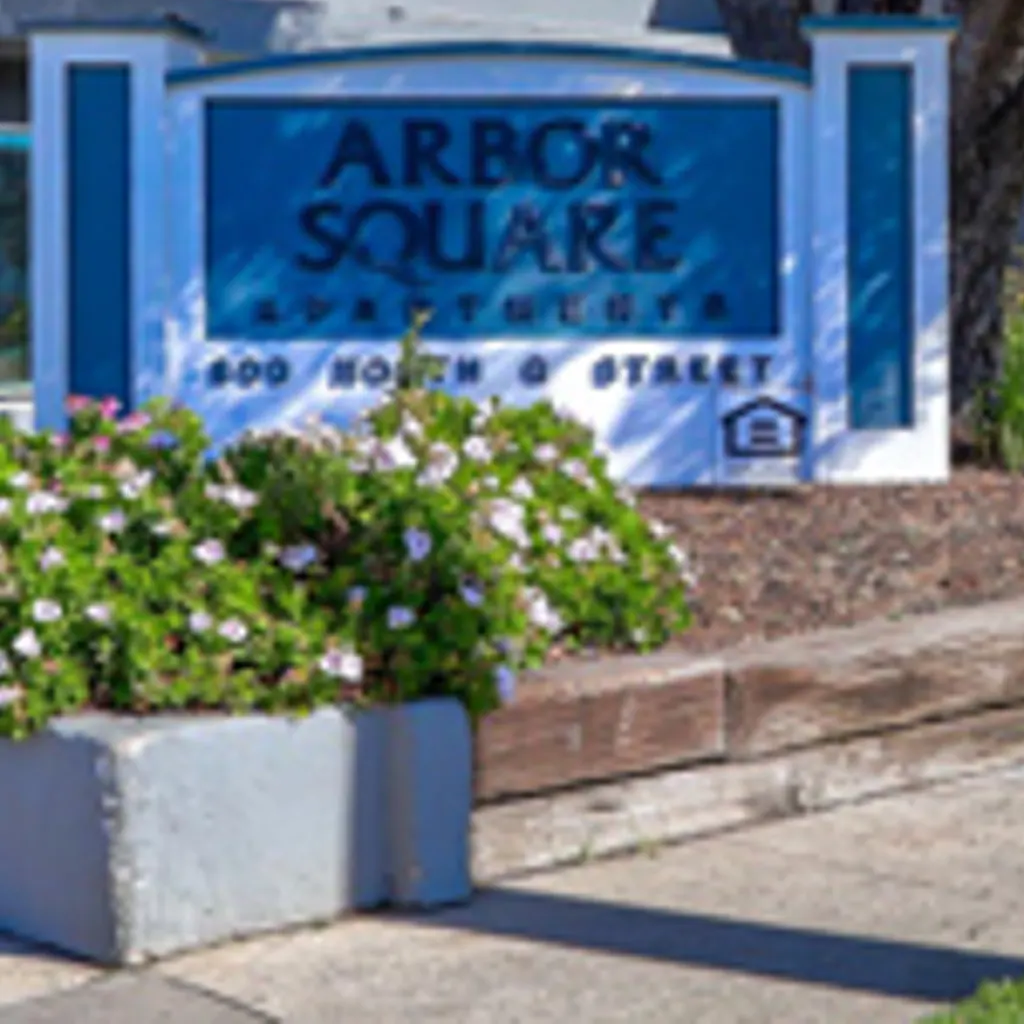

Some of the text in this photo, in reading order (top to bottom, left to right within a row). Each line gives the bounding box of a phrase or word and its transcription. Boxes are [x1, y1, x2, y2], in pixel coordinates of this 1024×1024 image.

[318, 119, 664, 188] ARBOR
[296, 199, 684, 286] SQUARE
[591, 353, 772, 388] STREET
